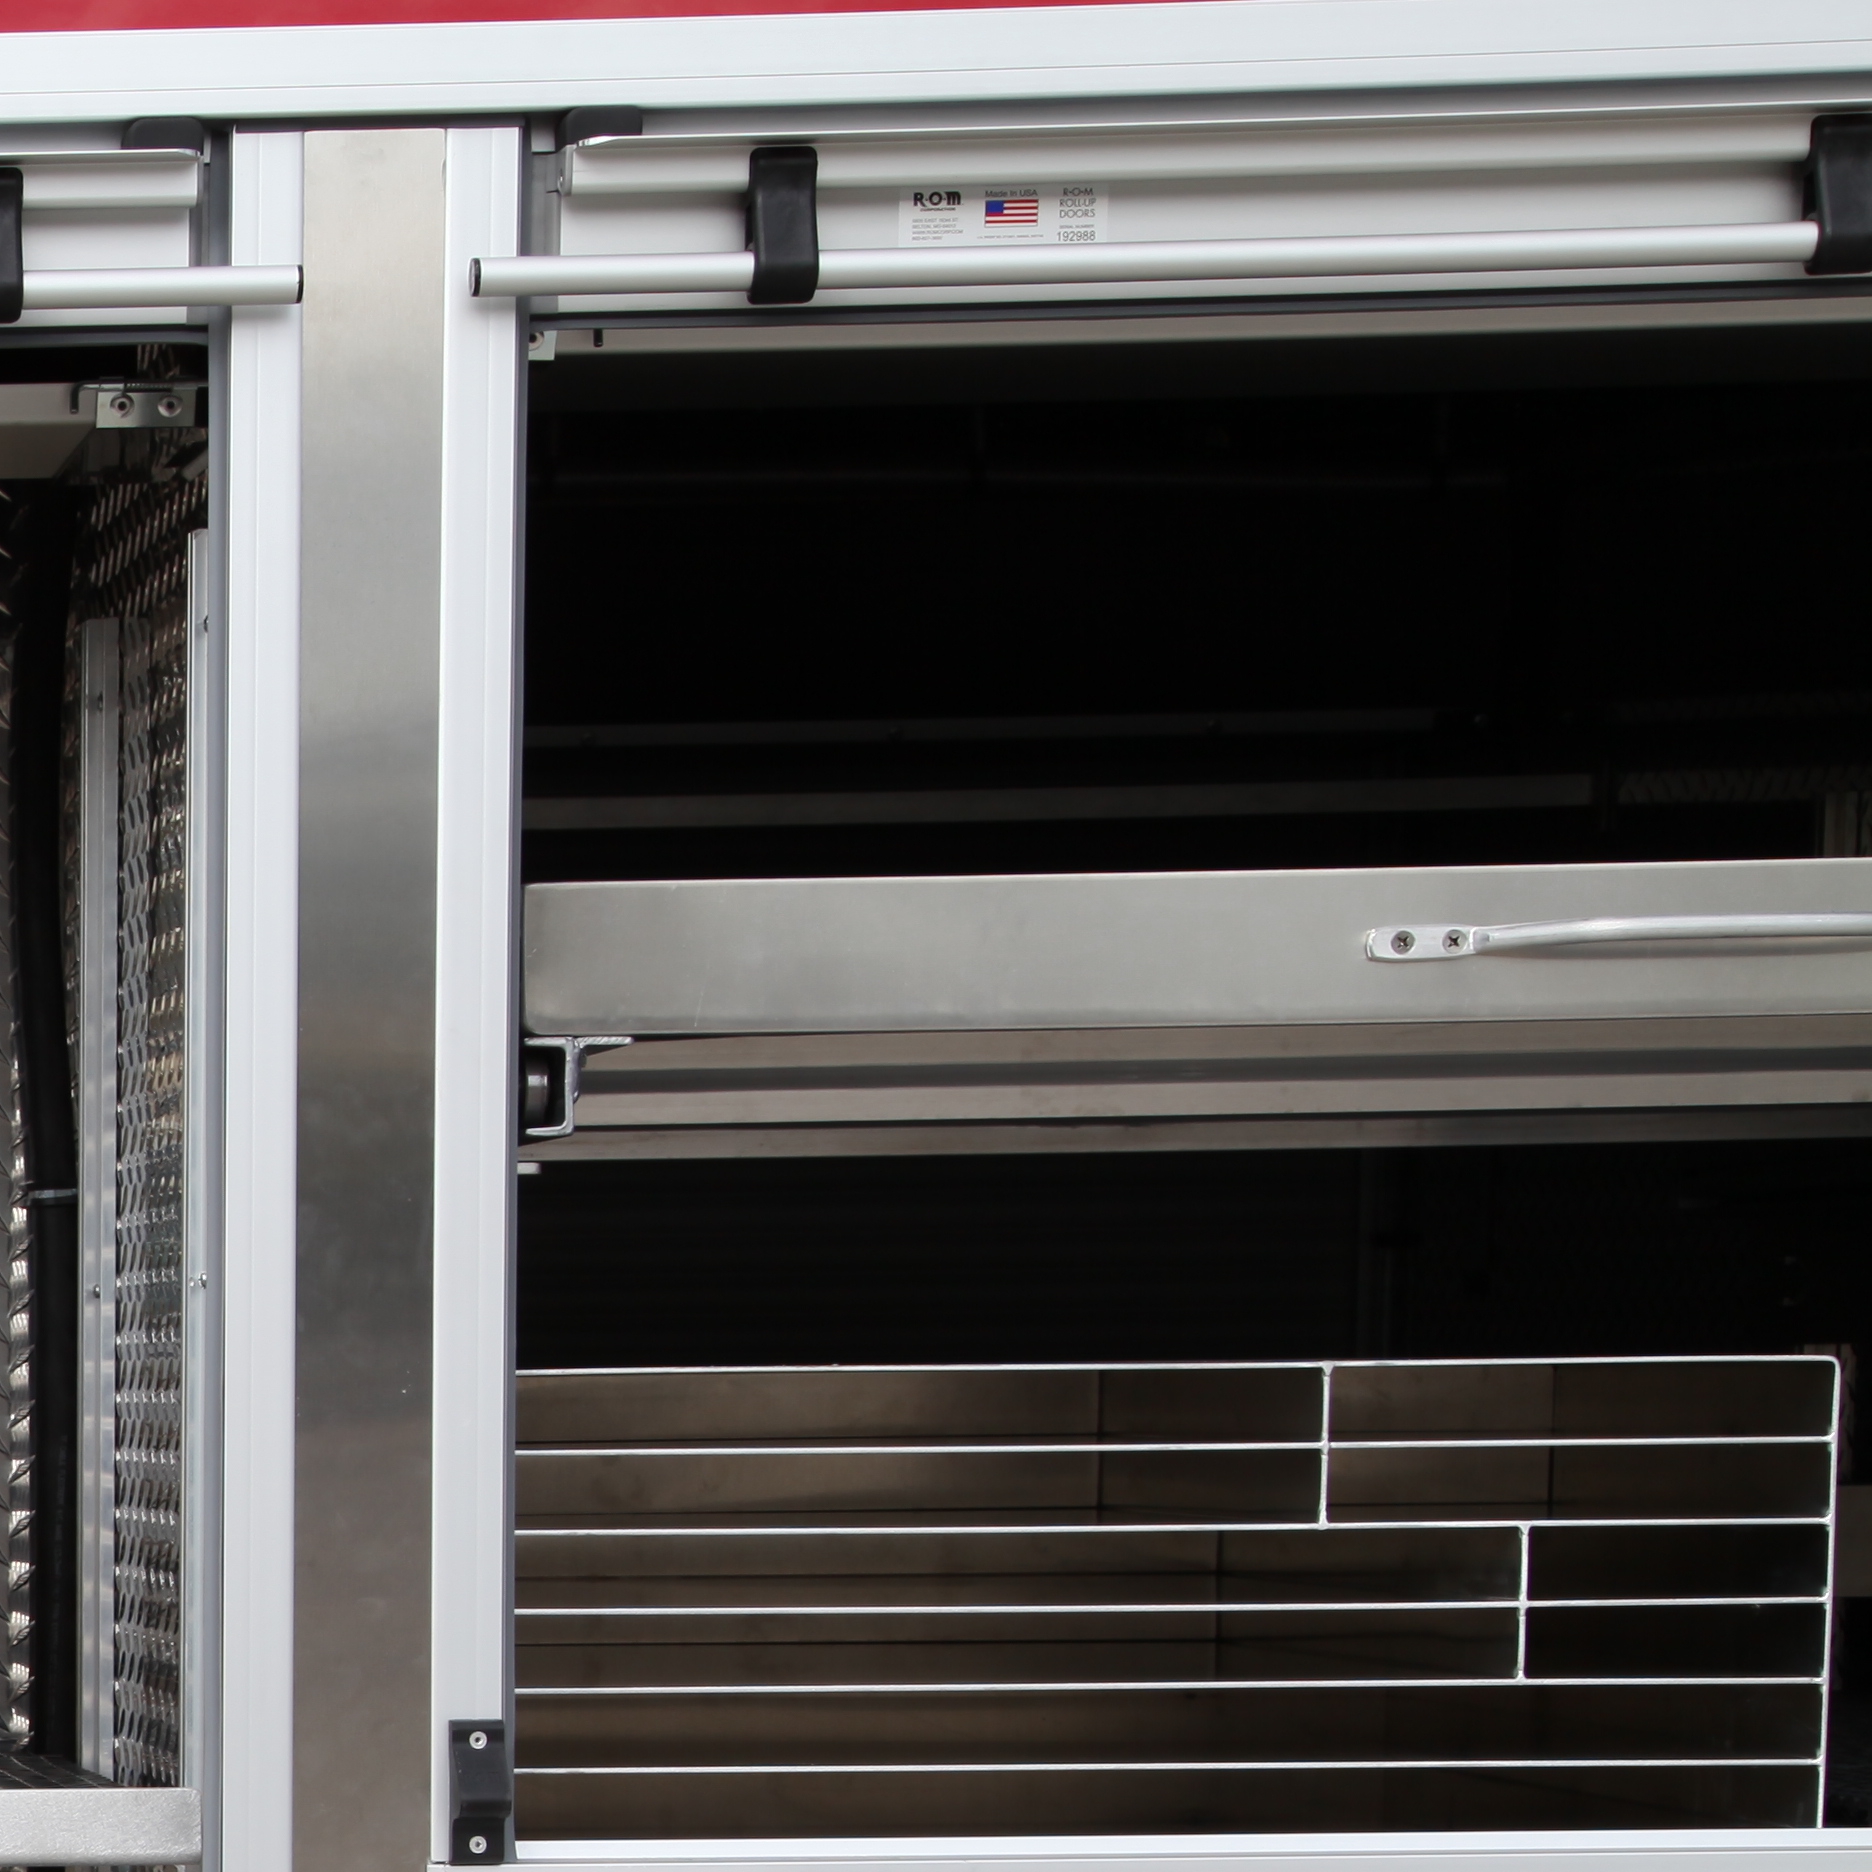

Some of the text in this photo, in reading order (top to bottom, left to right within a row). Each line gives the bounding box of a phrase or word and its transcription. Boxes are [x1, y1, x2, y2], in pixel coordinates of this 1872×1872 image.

[985, 190, 1008, 198] Made
[1019, 189, 1038, 197] USA
[1059, 208, 1096, 219] DOORS
[1057, 230, 1096, 242] 192988
